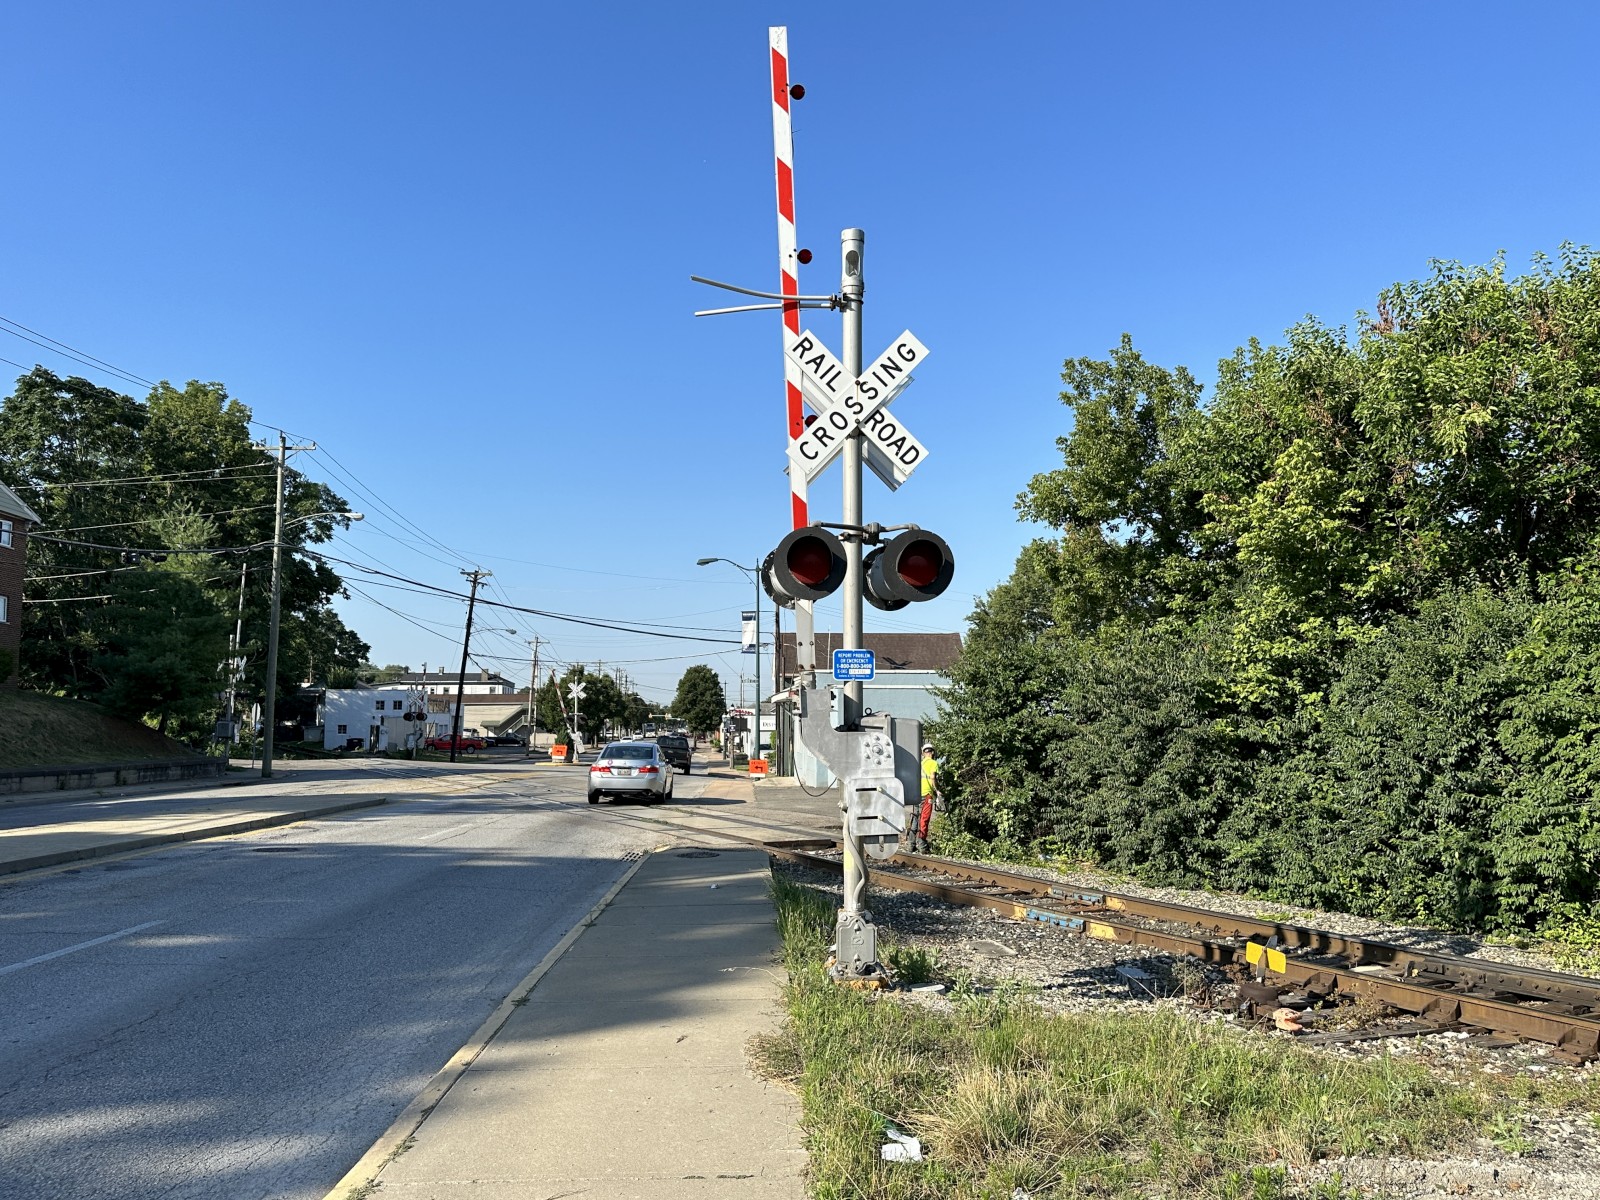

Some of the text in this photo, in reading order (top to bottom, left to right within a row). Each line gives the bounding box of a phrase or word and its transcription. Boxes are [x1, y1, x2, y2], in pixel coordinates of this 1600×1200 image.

[792, 336, 920, 466] RAIL ROAD
[799, 343, 916, 460] CROSSING
